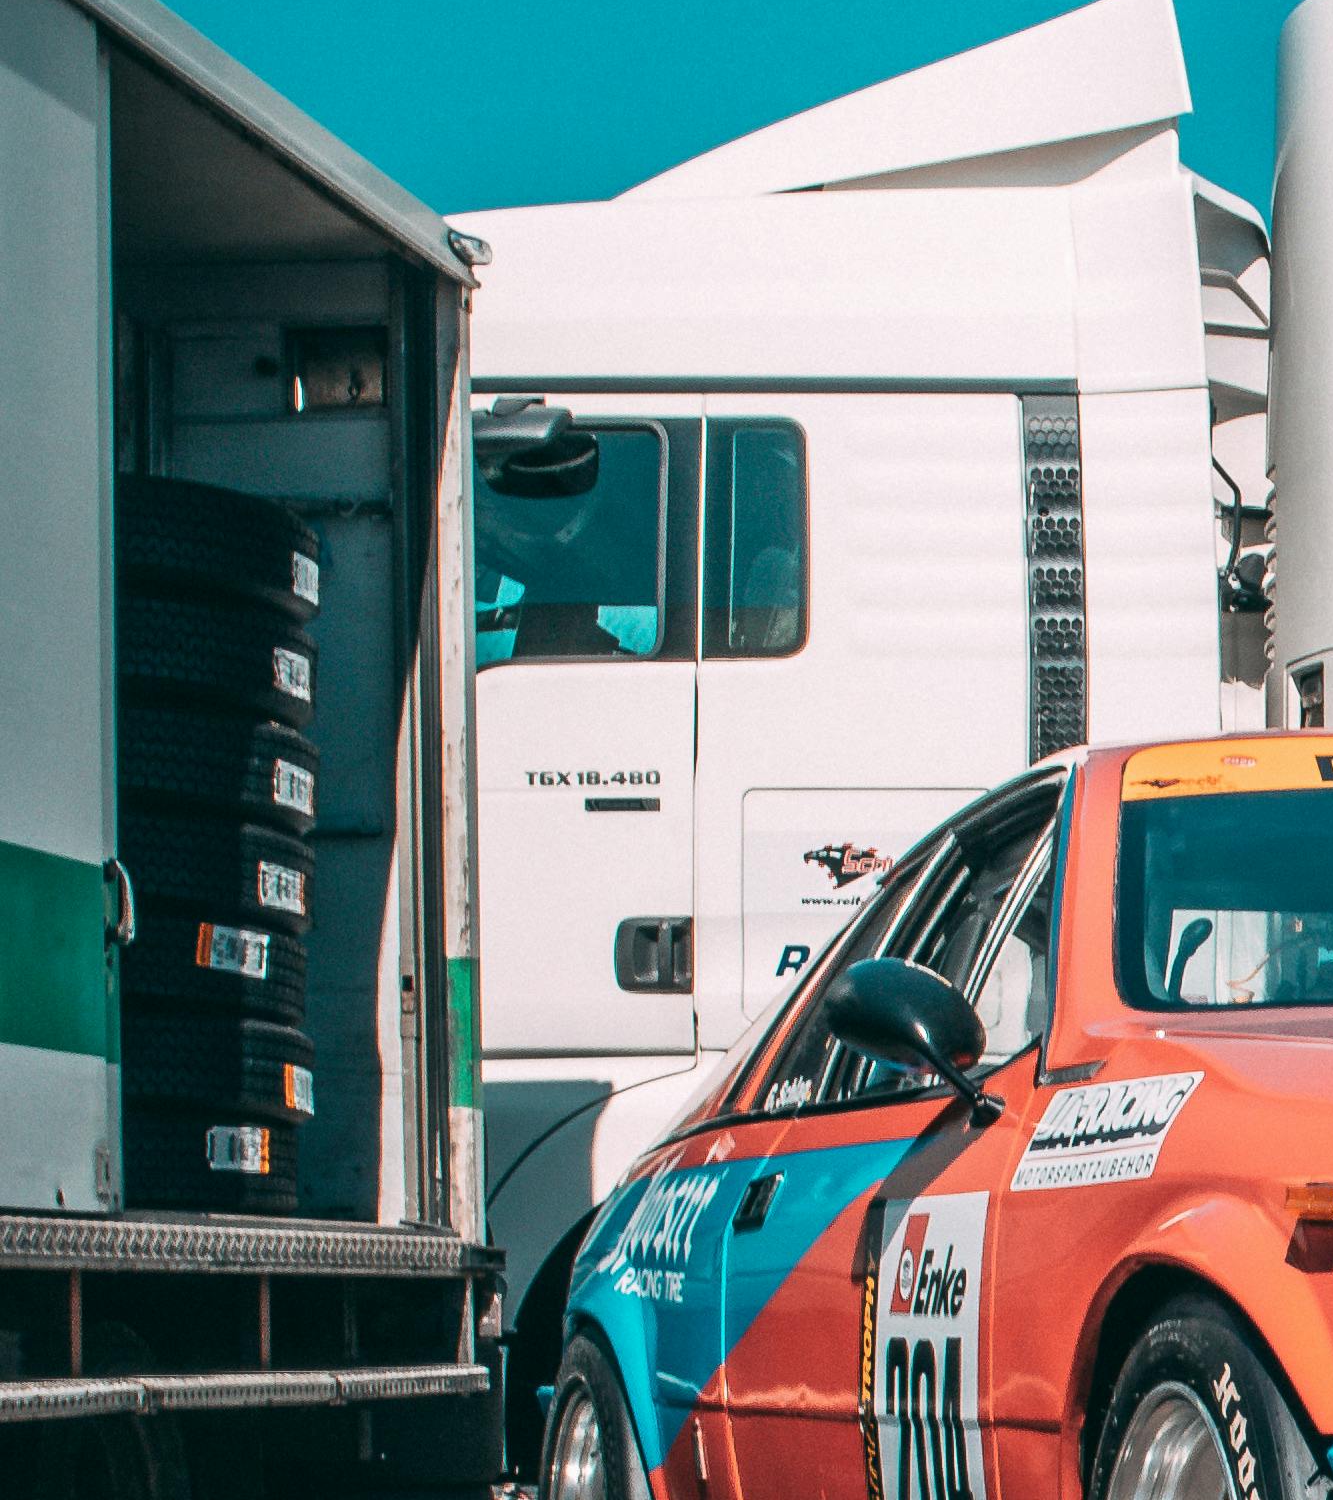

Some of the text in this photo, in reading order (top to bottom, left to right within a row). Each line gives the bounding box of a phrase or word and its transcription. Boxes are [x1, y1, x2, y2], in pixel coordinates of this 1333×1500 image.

[525, 770, 661, 786] TGX 18.480
[613, 1267, 686, 1302] RACING TIRE
[912, 1244, 967, 1318] Enke
